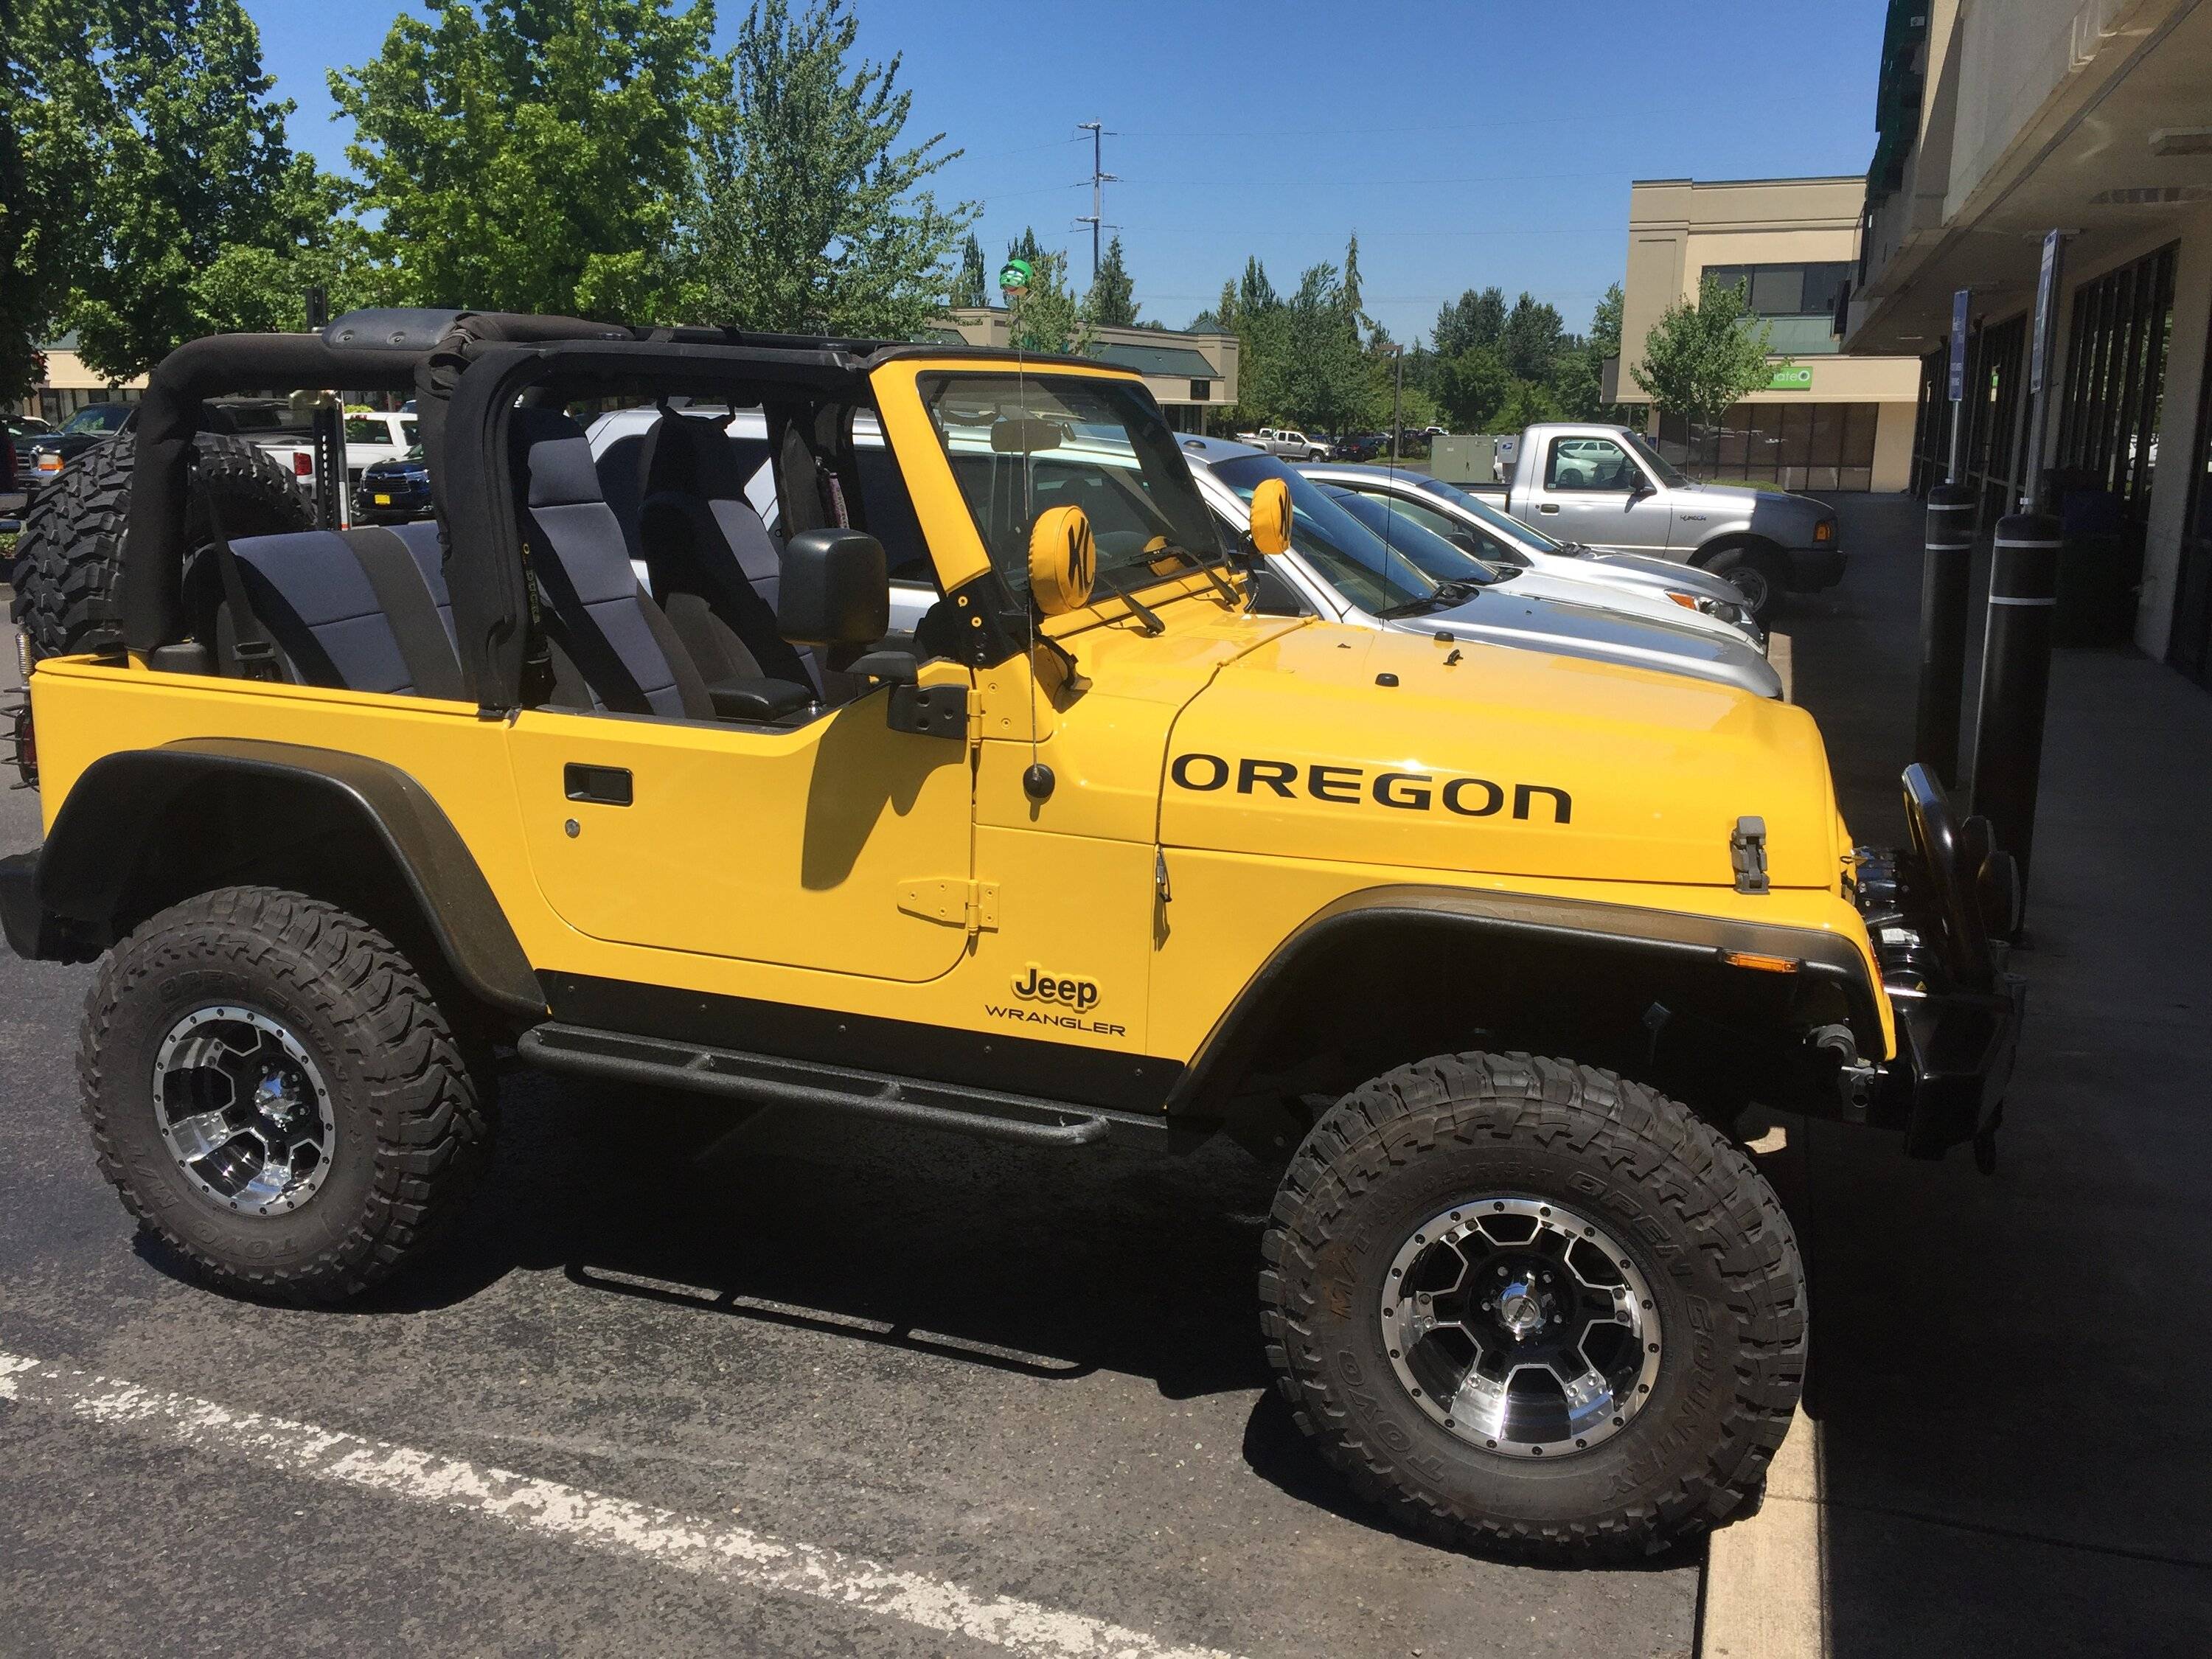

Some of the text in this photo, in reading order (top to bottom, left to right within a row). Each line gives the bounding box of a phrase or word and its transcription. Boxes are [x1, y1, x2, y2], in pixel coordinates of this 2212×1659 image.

[1068, 517, 1095, 597] KC
[1171, 754, 1572, 824] OREGON
[984, 1004, 1126, 1037] WRANGLER
[1015, 968, 1097, 1008] Jeep
[1338, 1350, 1444, 1482] TOYO
